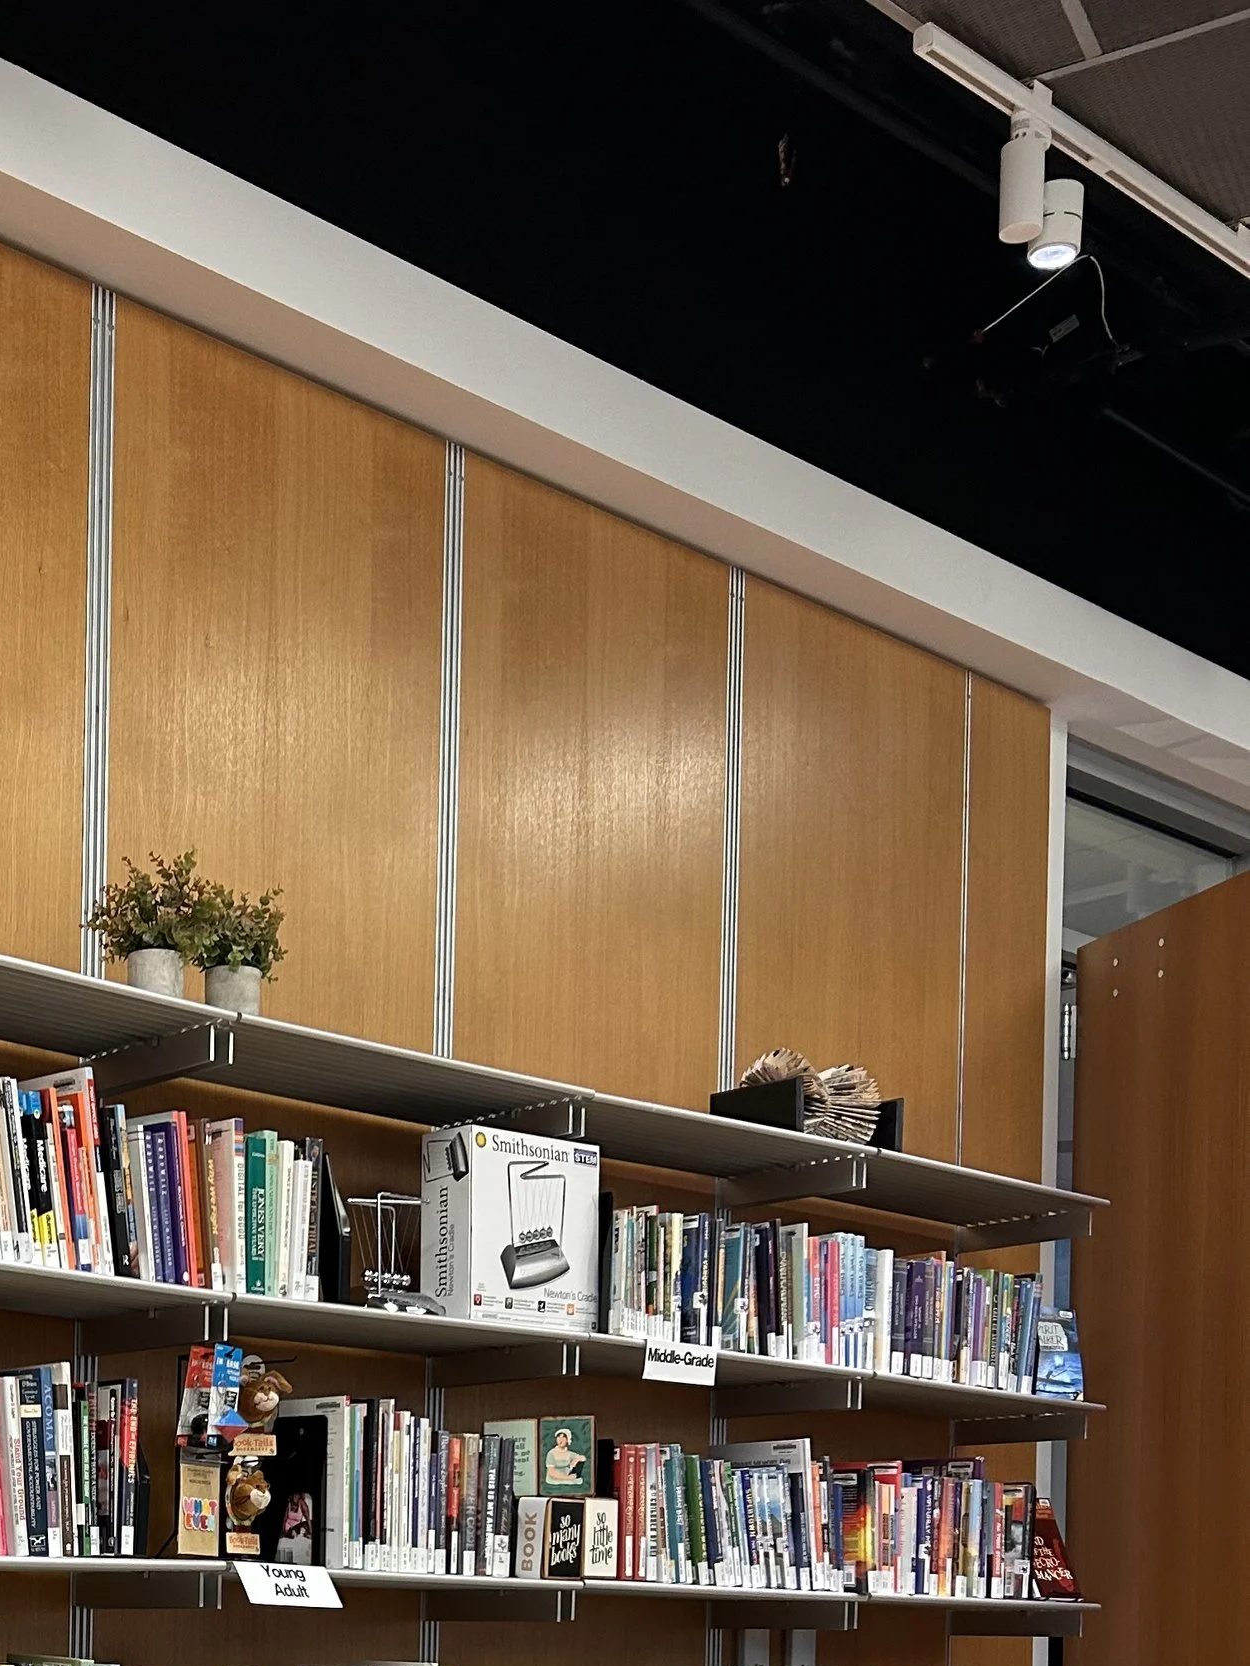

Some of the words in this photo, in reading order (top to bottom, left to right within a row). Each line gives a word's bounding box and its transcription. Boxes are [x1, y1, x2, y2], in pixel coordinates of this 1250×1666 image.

[492, 1134, 570, 1164] Smithsonian
[574, 1151, 598, 1166] STEM
[22, 1138, 32, 1190] Medicare
[37, 1140, 48, 1192] Medicare
[208, 1160, 216, 1183] Why
[210, 1187, 217, 1203] We
[435, 1185, 449, 1298] Smithsonian
[544, 1288, 576, 1300] Newton's
[577, 1291, 597, 1301] Cradle
[1039, 1335, 1063, 1345] ALKER
[648, 1348, 714, 1369] Middle-Grade
[45, 1385, 53, 1440] ACOMA
[15, 1466, 23, 1486] Your
[17, 1489, 25, 1520] Ground
[488, 1491, 494, 1499] IS
[182, 1497, 217, 1514] WHAT
[487, 1502, 494, 1516] MY
[183, 1513, 215, 1531] EVER
[560, 1515, 571, 1528] so
[596, 1513, 606, 1525] so
[521, 1512, 538, 1571] BOOK
[552, 1525, 581, 1547] many
[593, 1526, 613, 1547] little
[550, 1543, 577, 1566] books
[590, 1545, 613, 1565] time
[260, 1565, 306, 1582] Young
[1035, 1567, 1073, 1581] MANCER
[275, 1583, 309, 1598] Adult
